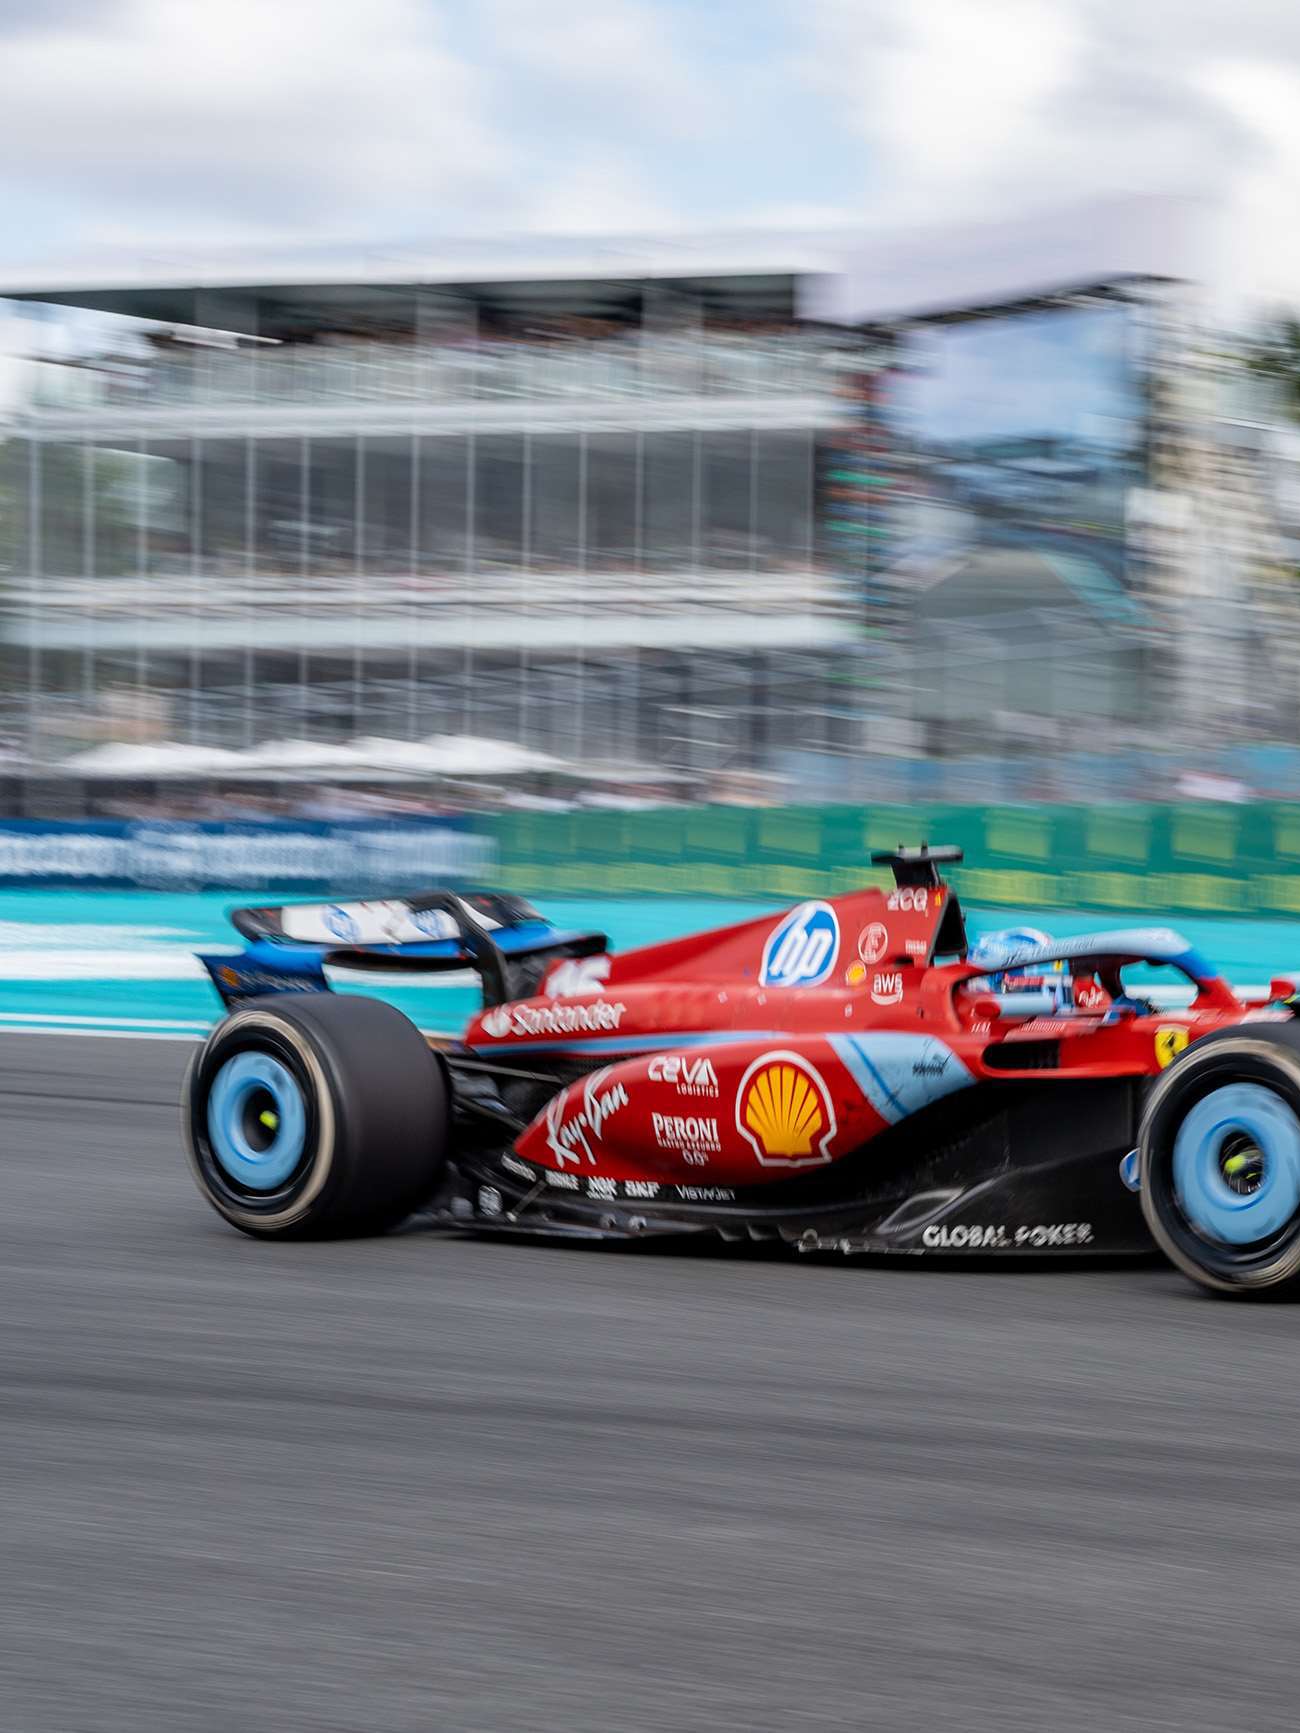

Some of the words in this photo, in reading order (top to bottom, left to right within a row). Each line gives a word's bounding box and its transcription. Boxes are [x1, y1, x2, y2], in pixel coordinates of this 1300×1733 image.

[764, 900, 838, 987] hp
[873, 972, 902, 994] aws
[511, 999, 627, 1036] Santander
[651, 1111, 719, 1142] PERONI
[922, 1225, 1013, 1247] GLOBAL
